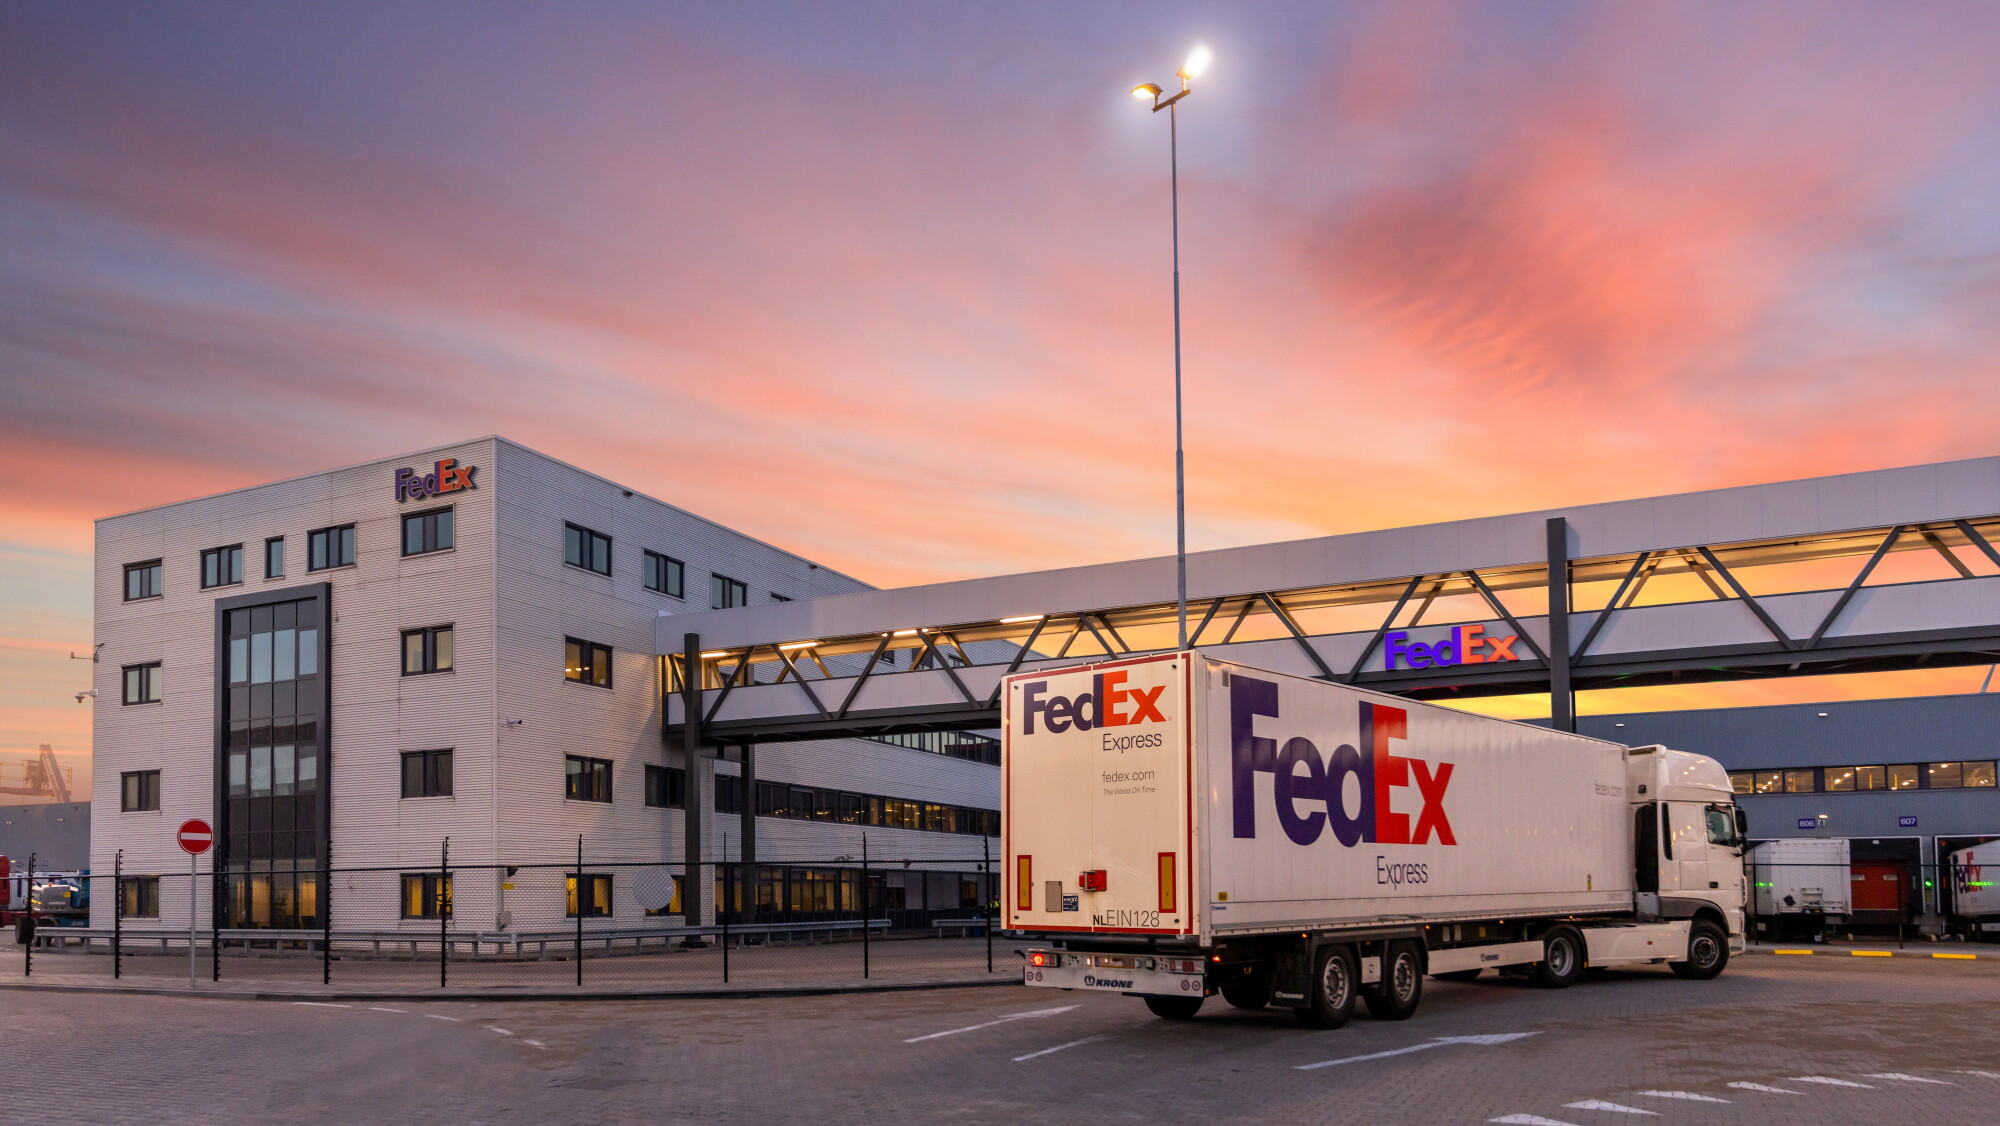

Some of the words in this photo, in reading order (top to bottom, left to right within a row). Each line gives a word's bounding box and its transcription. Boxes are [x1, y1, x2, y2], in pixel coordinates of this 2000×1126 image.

[394, 458, 475, 501] FedEx
[1384, 624, 1519, 670] FedEx
[1023, 670, 1167, 735] FedEx
[1102, 733, 1162, 754] Express
[1230, 674, 1457, 848] FedEx
[1102, 770, 1155, 783] fedex.com
[1103, 788, 1114, 796] The
[1115, 787, 1131, 795] World
[1132, 786, 1141, 794] On
[1142, 785, 1156, 793] Time
[1799, 820, 1815, 828] 606
[1900, 817, 1916, 825] 607
[1376, 855, 1428, 891] Express
[1096, 978, 1133, 989] KRONE
